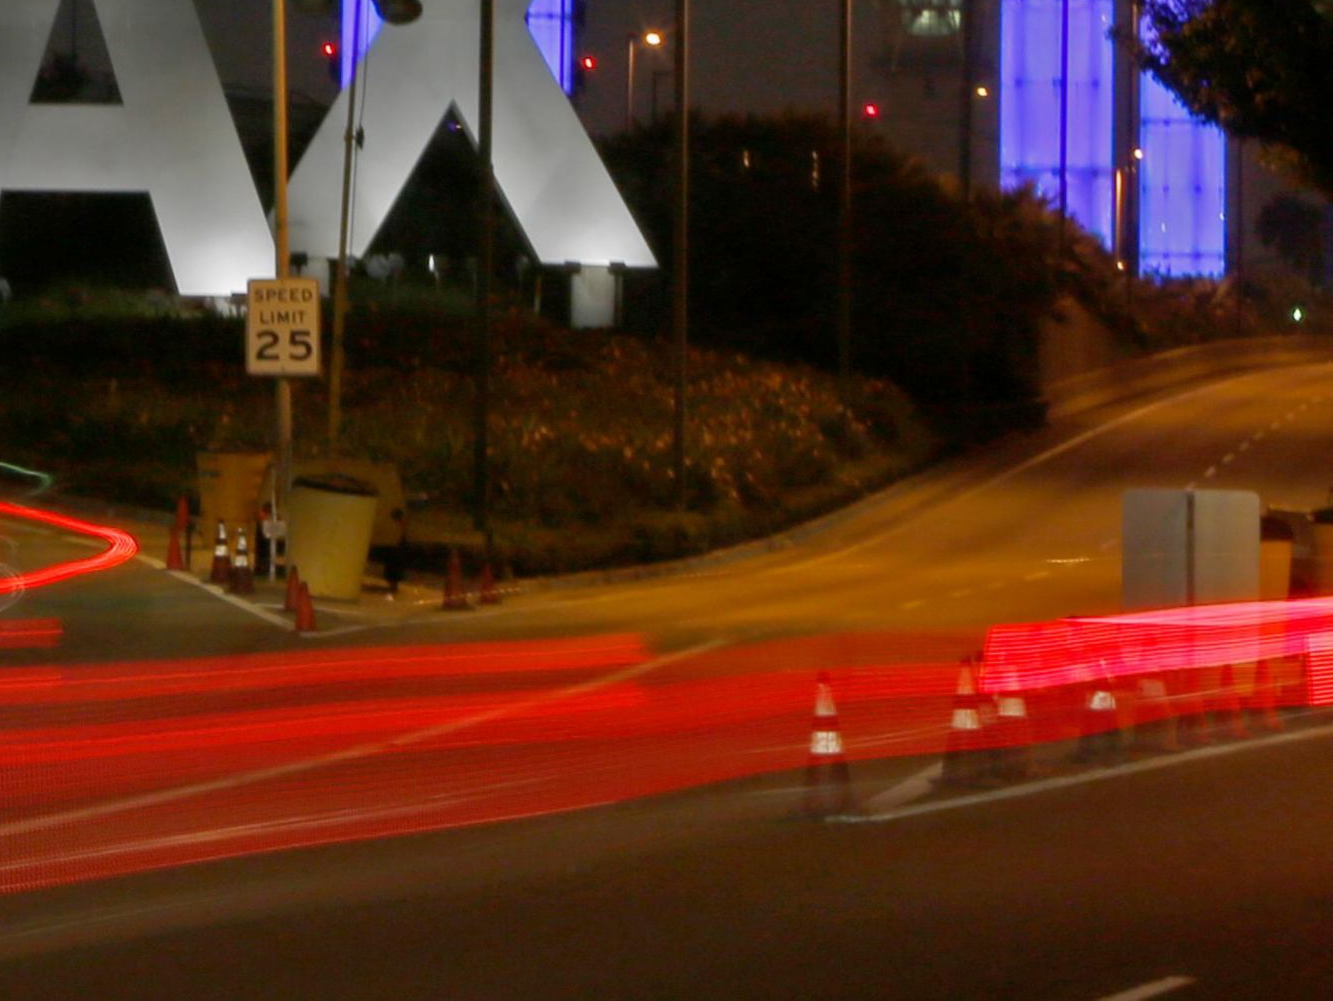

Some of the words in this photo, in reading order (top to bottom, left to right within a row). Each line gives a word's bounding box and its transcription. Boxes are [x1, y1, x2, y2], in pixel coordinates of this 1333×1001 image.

[253, 287, 313, 303] SPEED
[259, 310, 306, 325] LIMIT
[255, 329, 313, 362] 25
